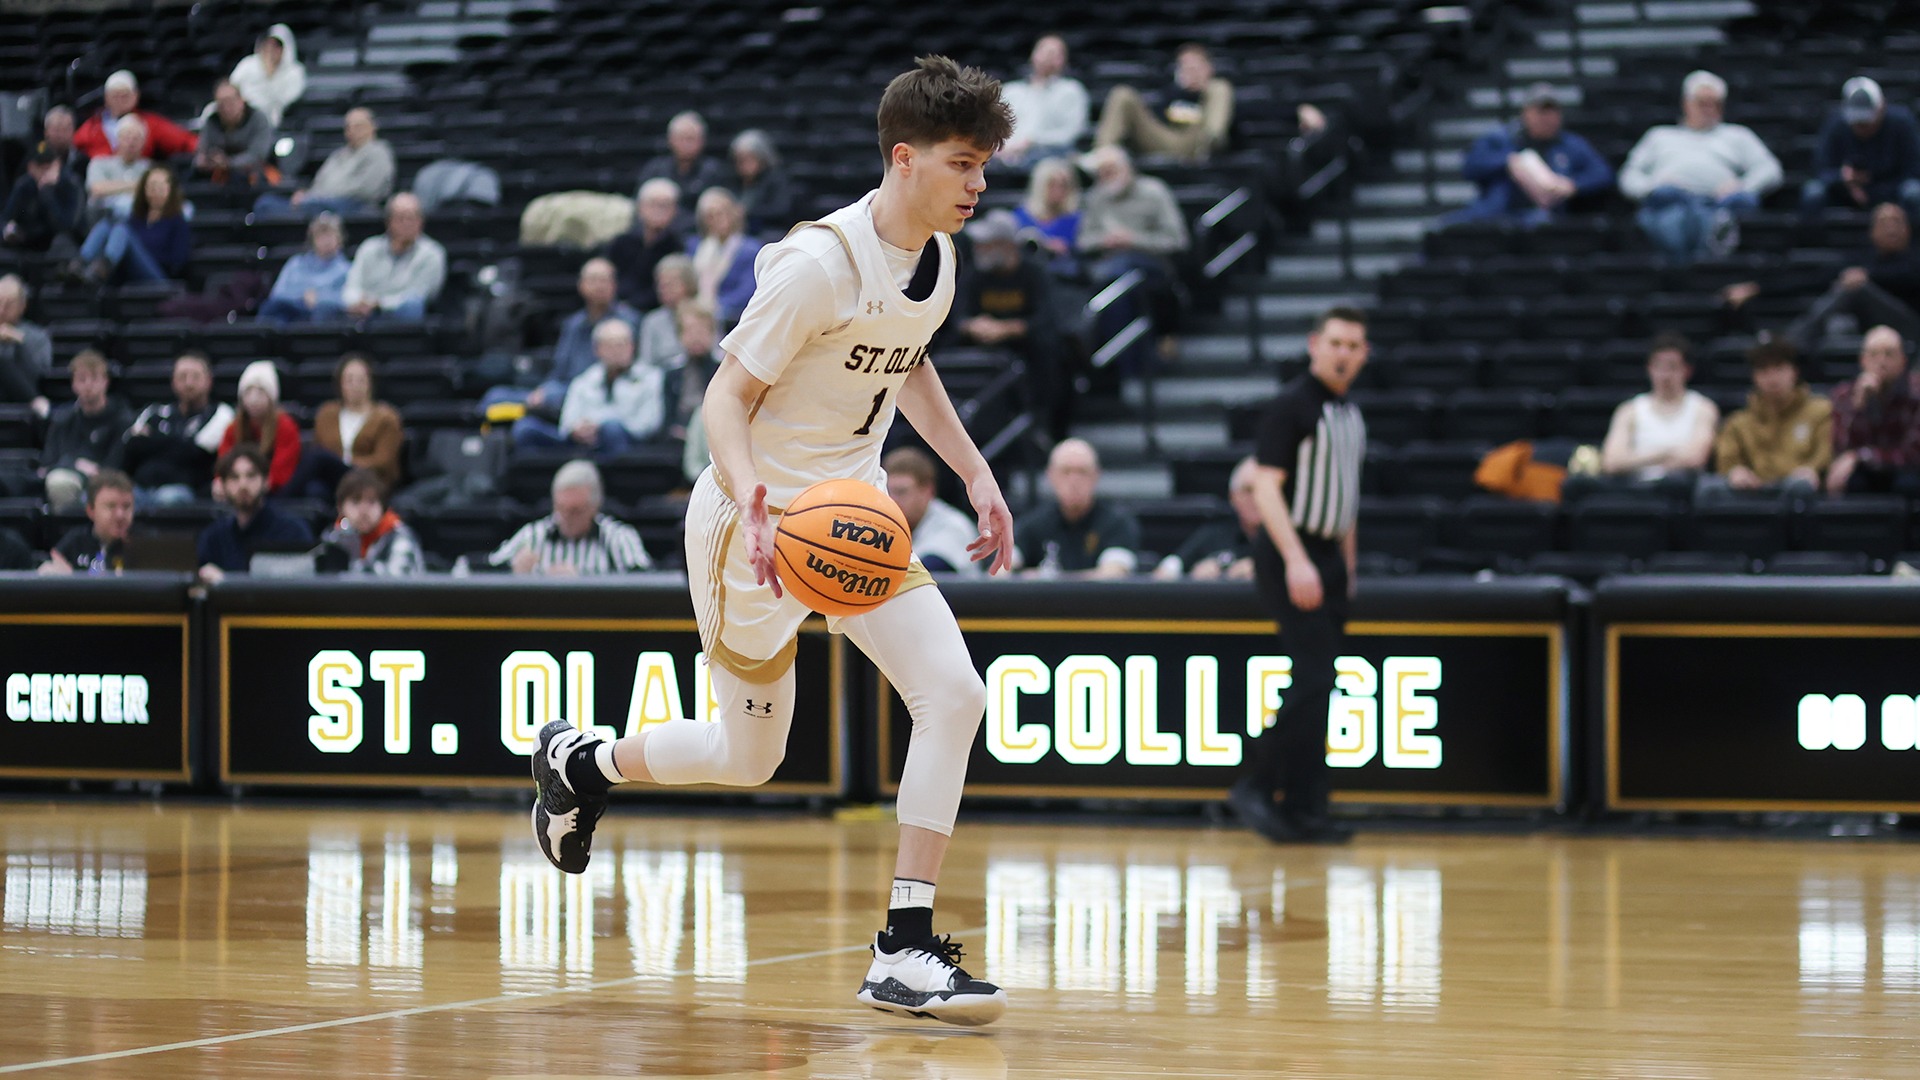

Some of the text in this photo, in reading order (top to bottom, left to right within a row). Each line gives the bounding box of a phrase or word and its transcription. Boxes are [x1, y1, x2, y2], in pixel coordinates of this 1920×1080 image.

[844, 343, 886, 374] ST.
[853, 386, 888, 436] 1
[831, 519, 895, 553] NCAA
[806, 552, 891, 597] Wilson
[6, 672, 150, 724] CENTER
[308, 649, 459, 755] ST.
